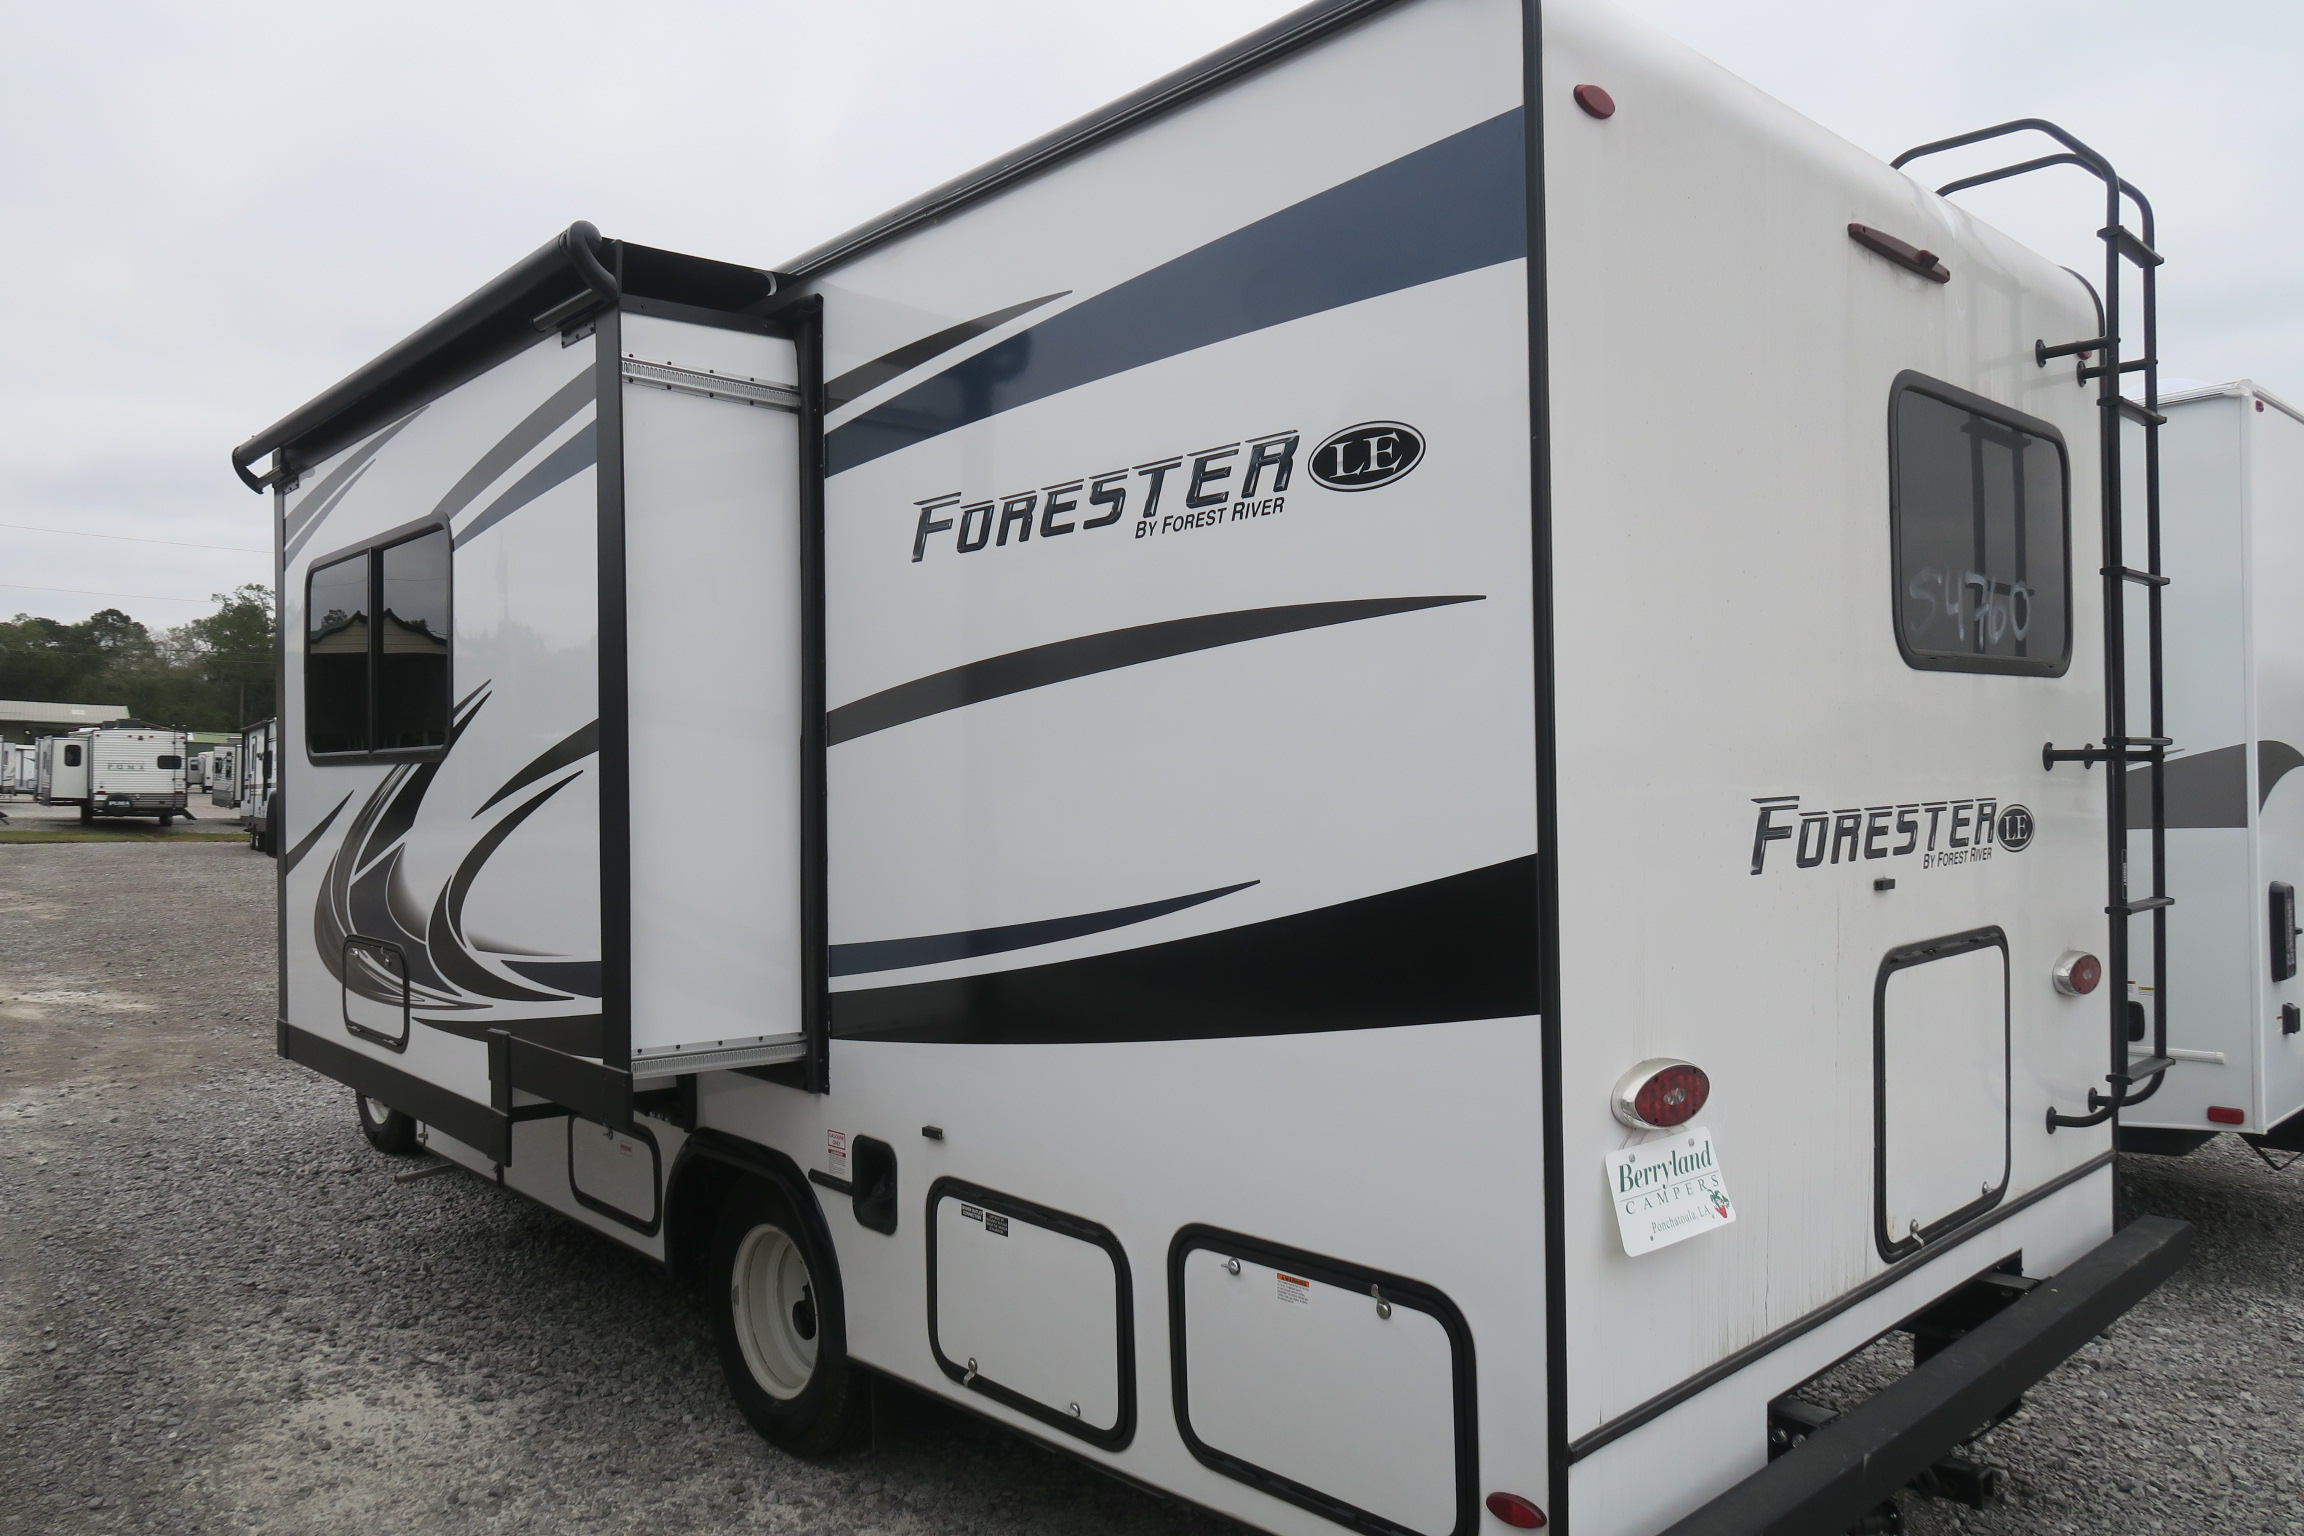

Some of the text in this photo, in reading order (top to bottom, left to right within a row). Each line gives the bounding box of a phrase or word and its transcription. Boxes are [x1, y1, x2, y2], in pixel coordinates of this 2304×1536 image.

[911, 430, 1299, 563] FORESTER
[1135, 497, 1285, 539] BY FOREST RIVER
[1750, 796, 1997, 875] FORESTER
[1923, 847, 1993, 869] BY FOREST RIVER
[1618, 1140, 1712, 1193] Berryland
[1625, 1174, 1720, 1215] CAMPERS
[1697, 1205, 1712, 1218] LA
